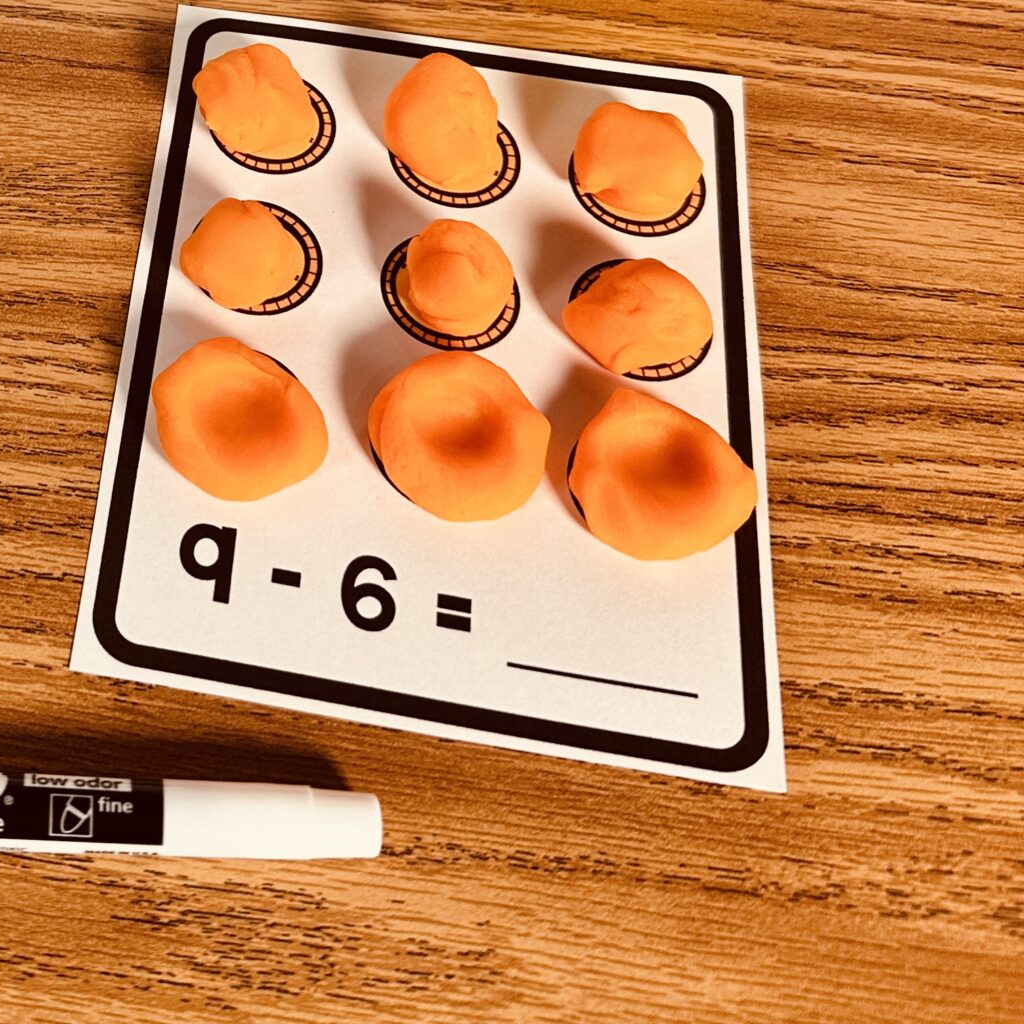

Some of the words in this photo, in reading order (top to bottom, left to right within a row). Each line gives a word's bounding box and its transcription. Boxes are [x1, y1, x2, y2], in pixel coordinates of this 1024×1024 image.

[179, 522, 238, 604] 9
[340, 554, 398, 632] 6
[30, 774, 69, 788] low
[73, 775, 123, 790] odor
[97, 797, 134, 814] fine
